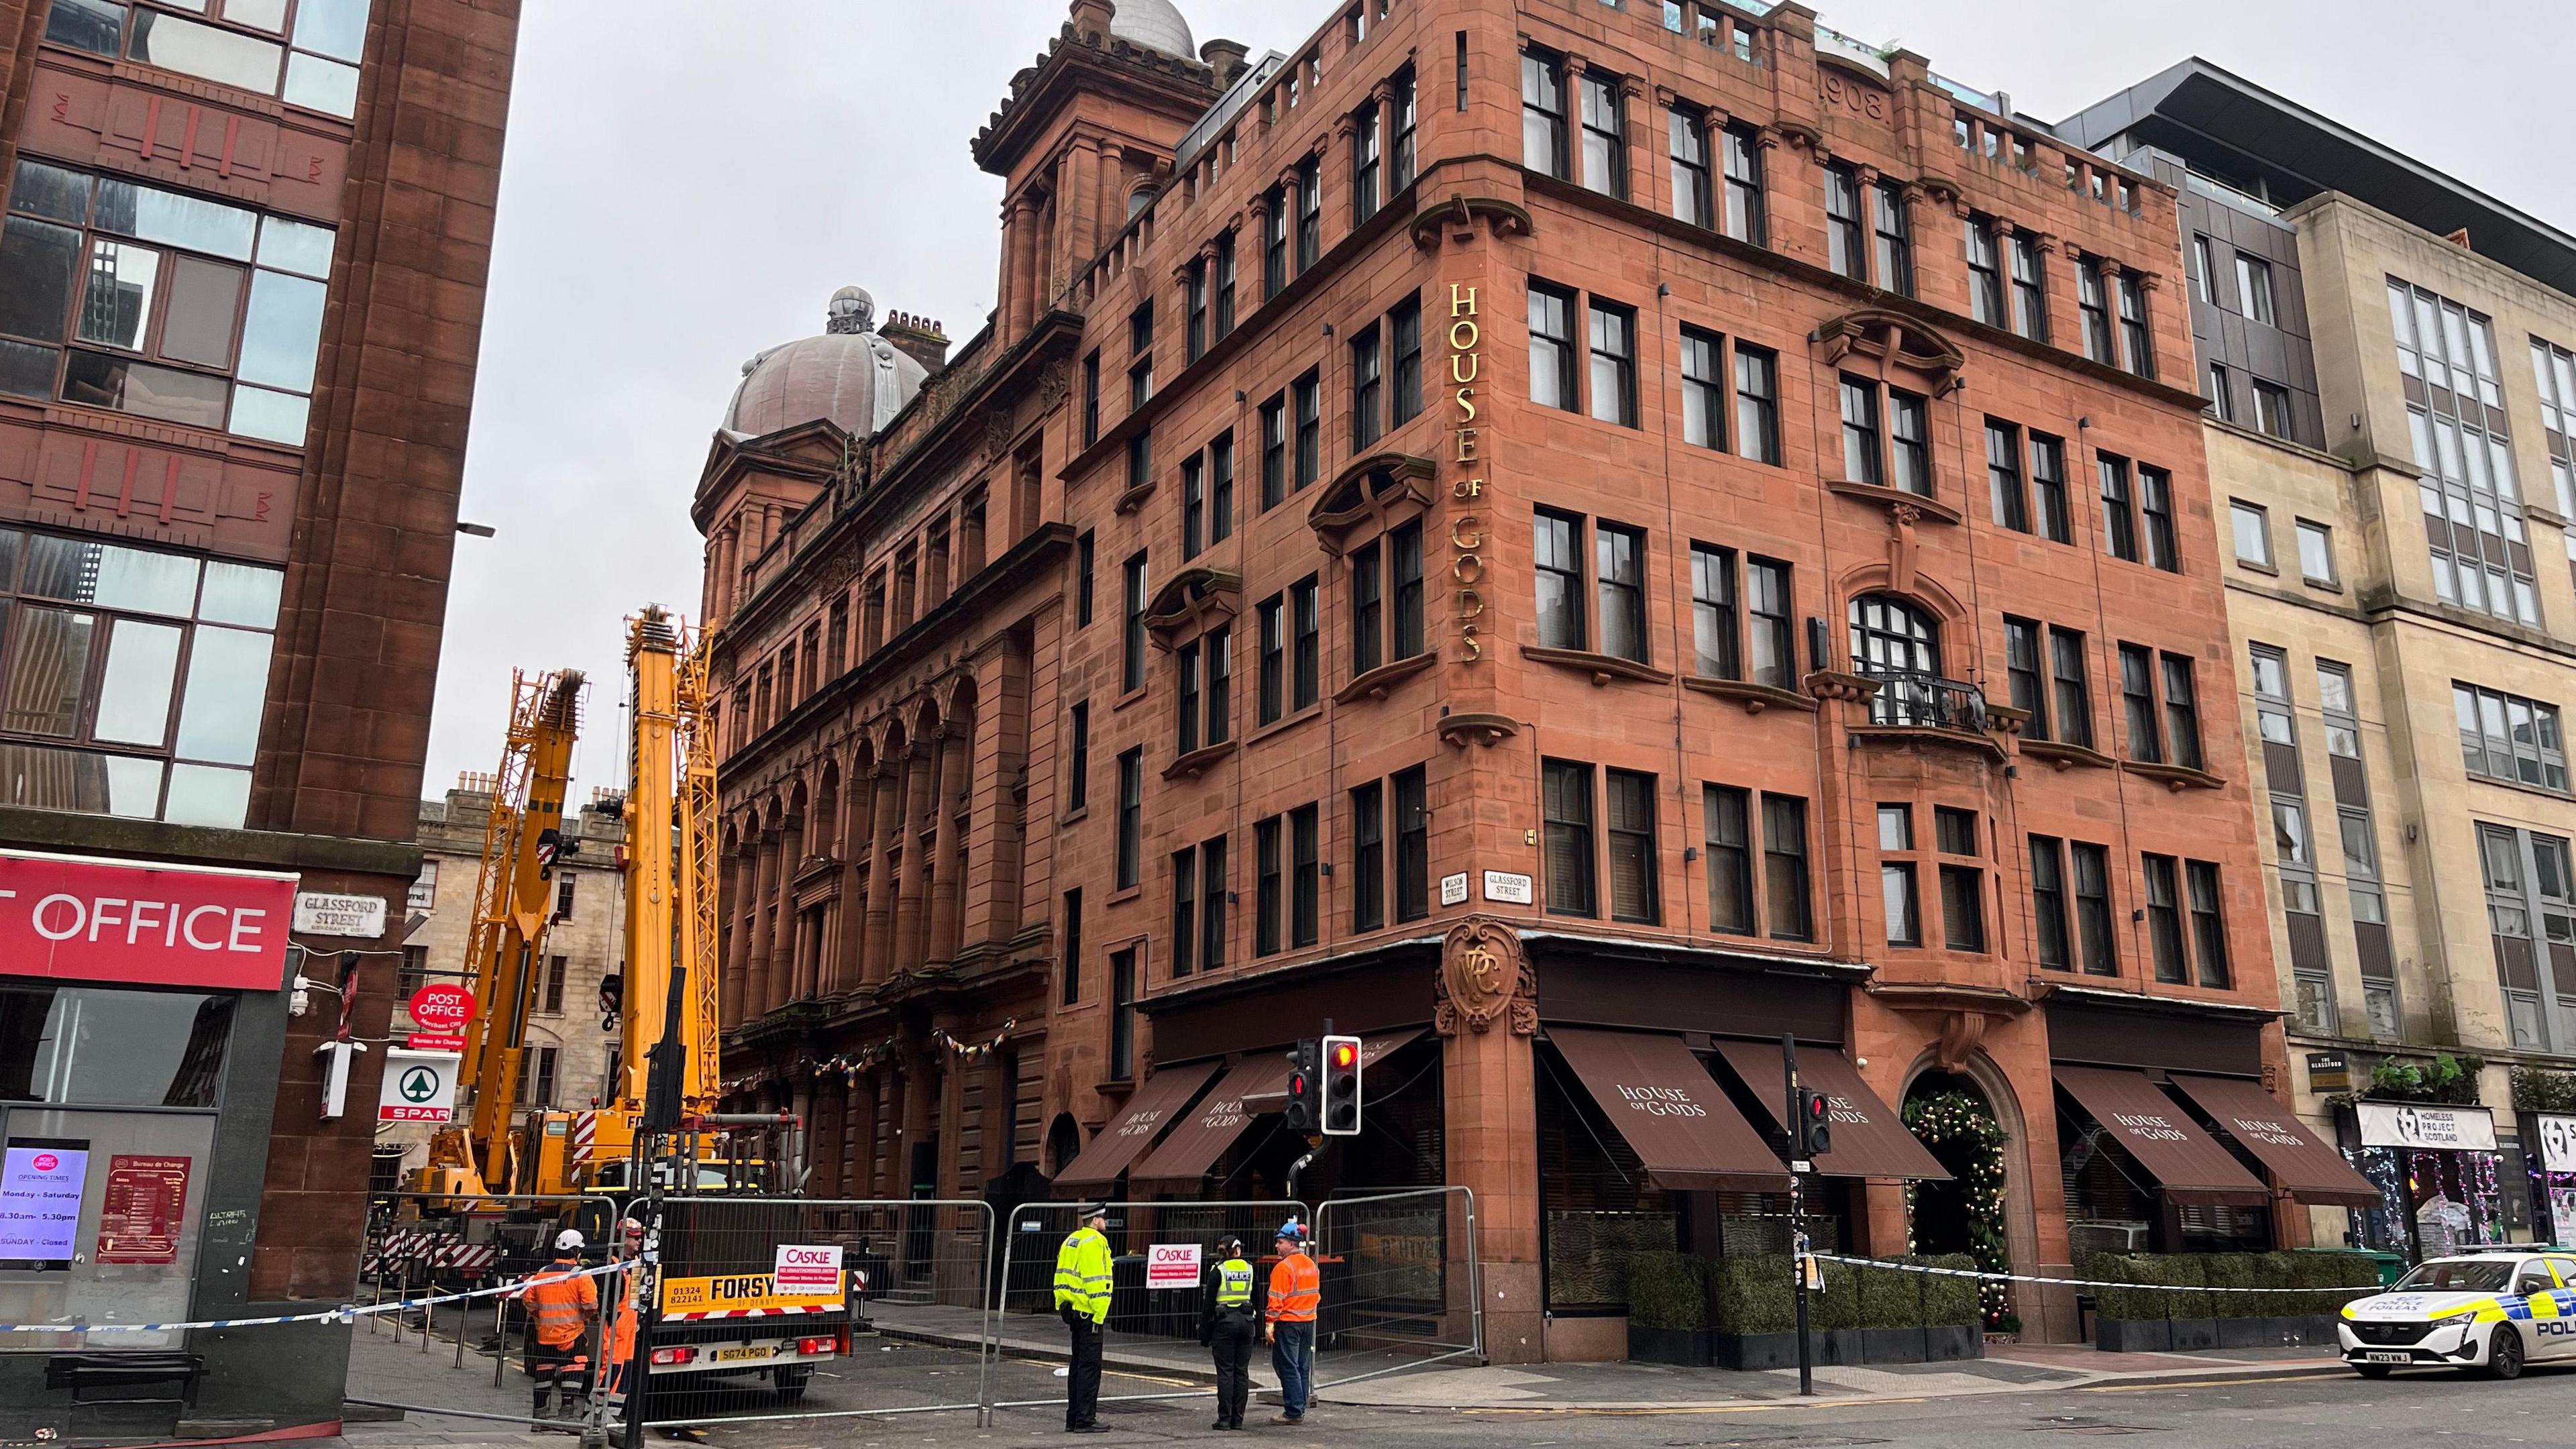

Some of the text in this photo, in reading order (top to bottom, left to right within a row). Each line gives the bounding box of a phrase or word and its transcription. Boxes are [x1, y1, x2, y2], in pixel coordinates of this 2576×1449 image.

[1450, 283, 1479, 463] HOUSE
[1454, 478, 1483, 498] OF
[1452, 515, 1484, 663] GODS
[1444, 876, 1463, 888] WILSON
[1489, 874, 1527, 887] GLASSFORD
[1445, 886, 1463, 899] STREET
[1496, 885, 1521, 896] STREET
[305, 898, 378, 913] GLASSFORD
[32, 893, 266, 953] OFFICE
[315, 912, 364, 926] STREET
[427, 993, 462, 1006] POST
[418, 1004, 465, 1017] OFFICE
[420, 1017, 448, 1028] Merchant
[1616, 1084, 1690, 1102] HOUSE
[393, 1108, 449, 1120] SPAR
[1209, 1101, 1242, 1114] HOUS
[1630, 1101, 1707, 1116] OF GODS
[1125, 1110, 1163, 1126] HOUSE
[1206, 1114, 1242, 1128] GODS
[2112, 1112, 2171, 1128] HOUSE
[2420, 1112, 2454, 1121] HOMELESS
[1120, 1123, 1152, 1136] GODS
[2234, 1118, 2287, 1134] HOUSE
[2422, 1122, 2455, 1131] PROJECT
[2141, 1127, 2188, 1141] GODS
[2260, 1132, 2304, 1146] GODS
[2424, 1132, 2457, 1141] SCOTLAND
[3, 1191, 35, 1199] Monday
[42, 1191, 80, 1200] Saturday
[786, 1249, 831, 1264] CASKIE
[1157, 1248, 1192, 1261] CASKIE
[1226, 1271, 1250, 1280] POLICE
[674, 1287, 700, 1295] 01324
[671, 1295, 703, 1303] 822141
[750, 1298, 774, 1306] DENNY
[723, 1349, 746, 1359] SG74
